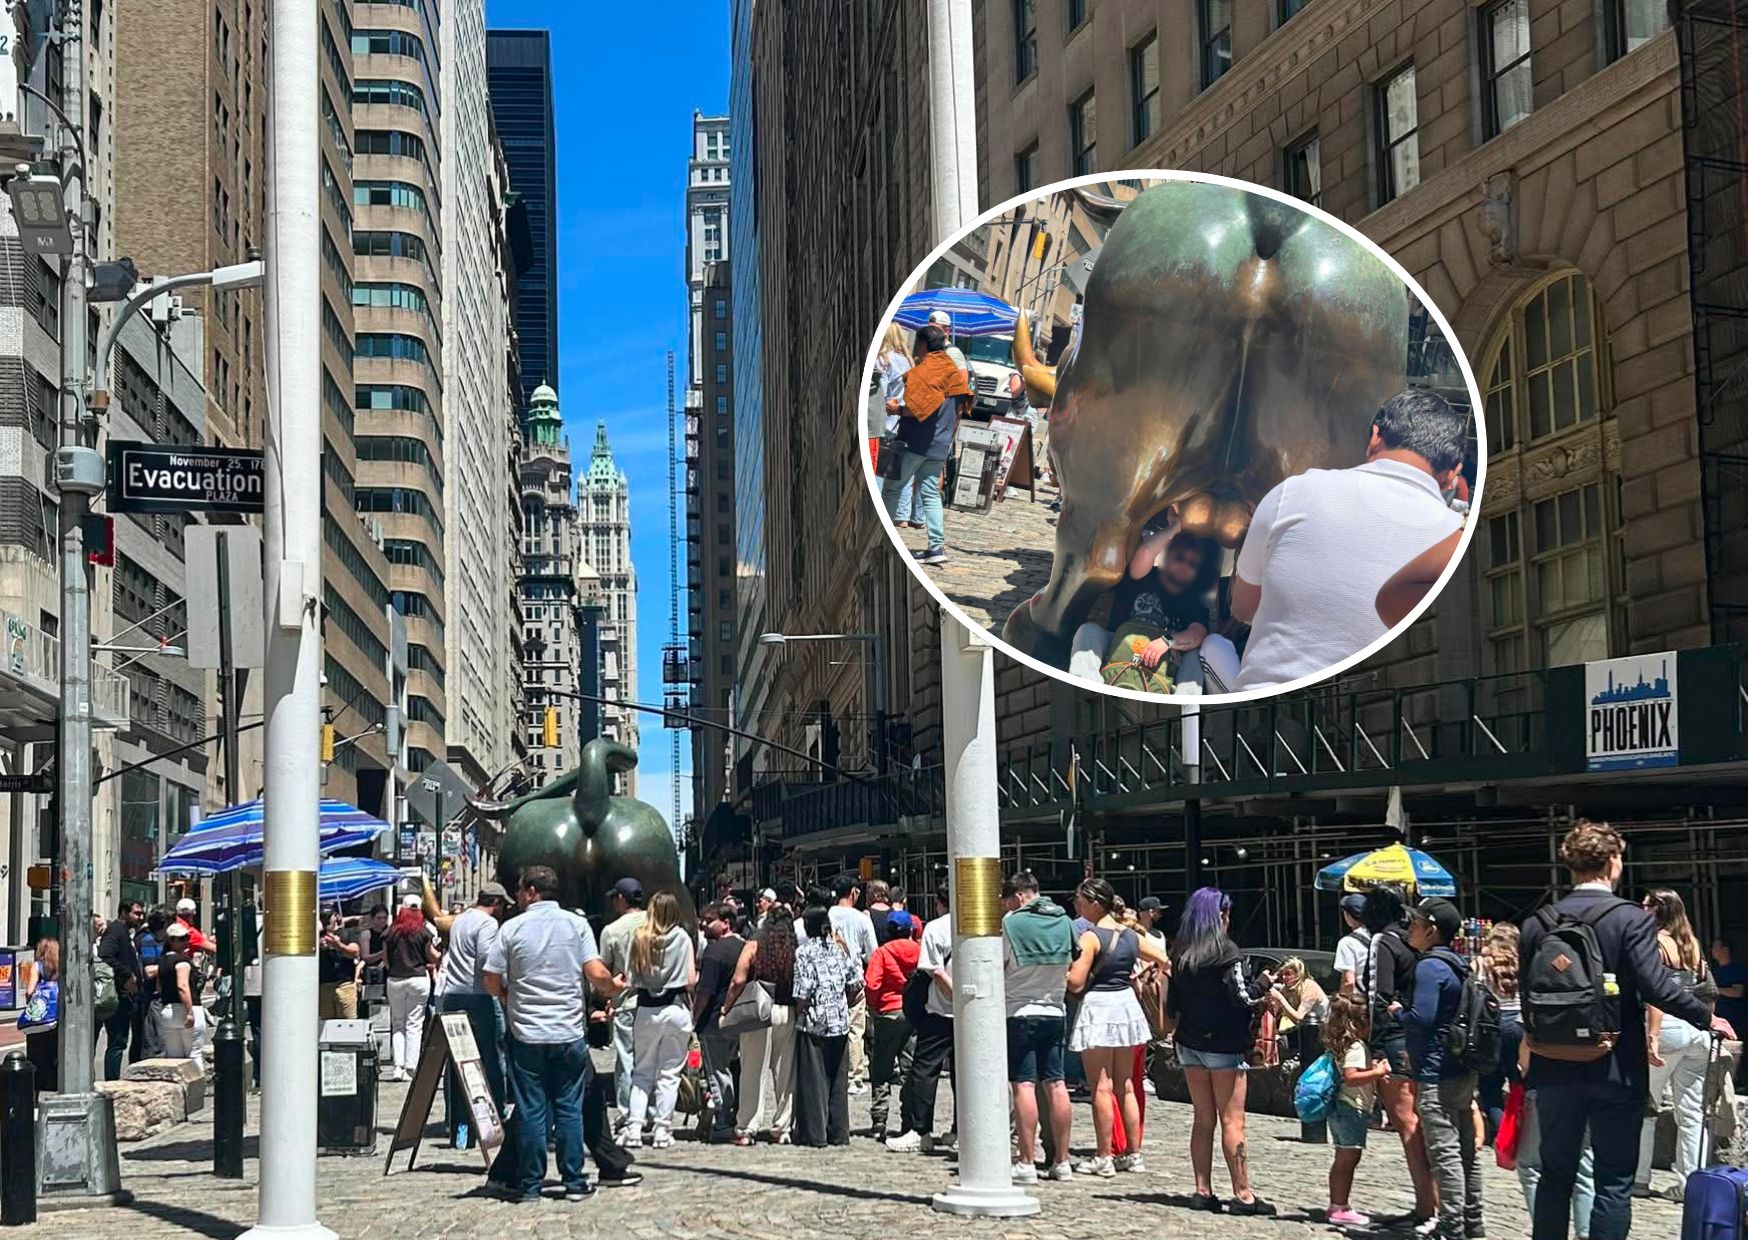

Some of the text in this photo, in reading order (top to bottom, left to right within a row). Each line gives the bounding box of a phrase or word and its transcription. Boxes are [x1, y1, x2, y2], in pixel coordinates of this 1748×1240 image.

[169, 455, 220, 468] November
[129, 463, 261, 493] Evacuation
[206, 490, 238, 503] PLAZA
[1591, 702, 1672, 753] PHOENIX
